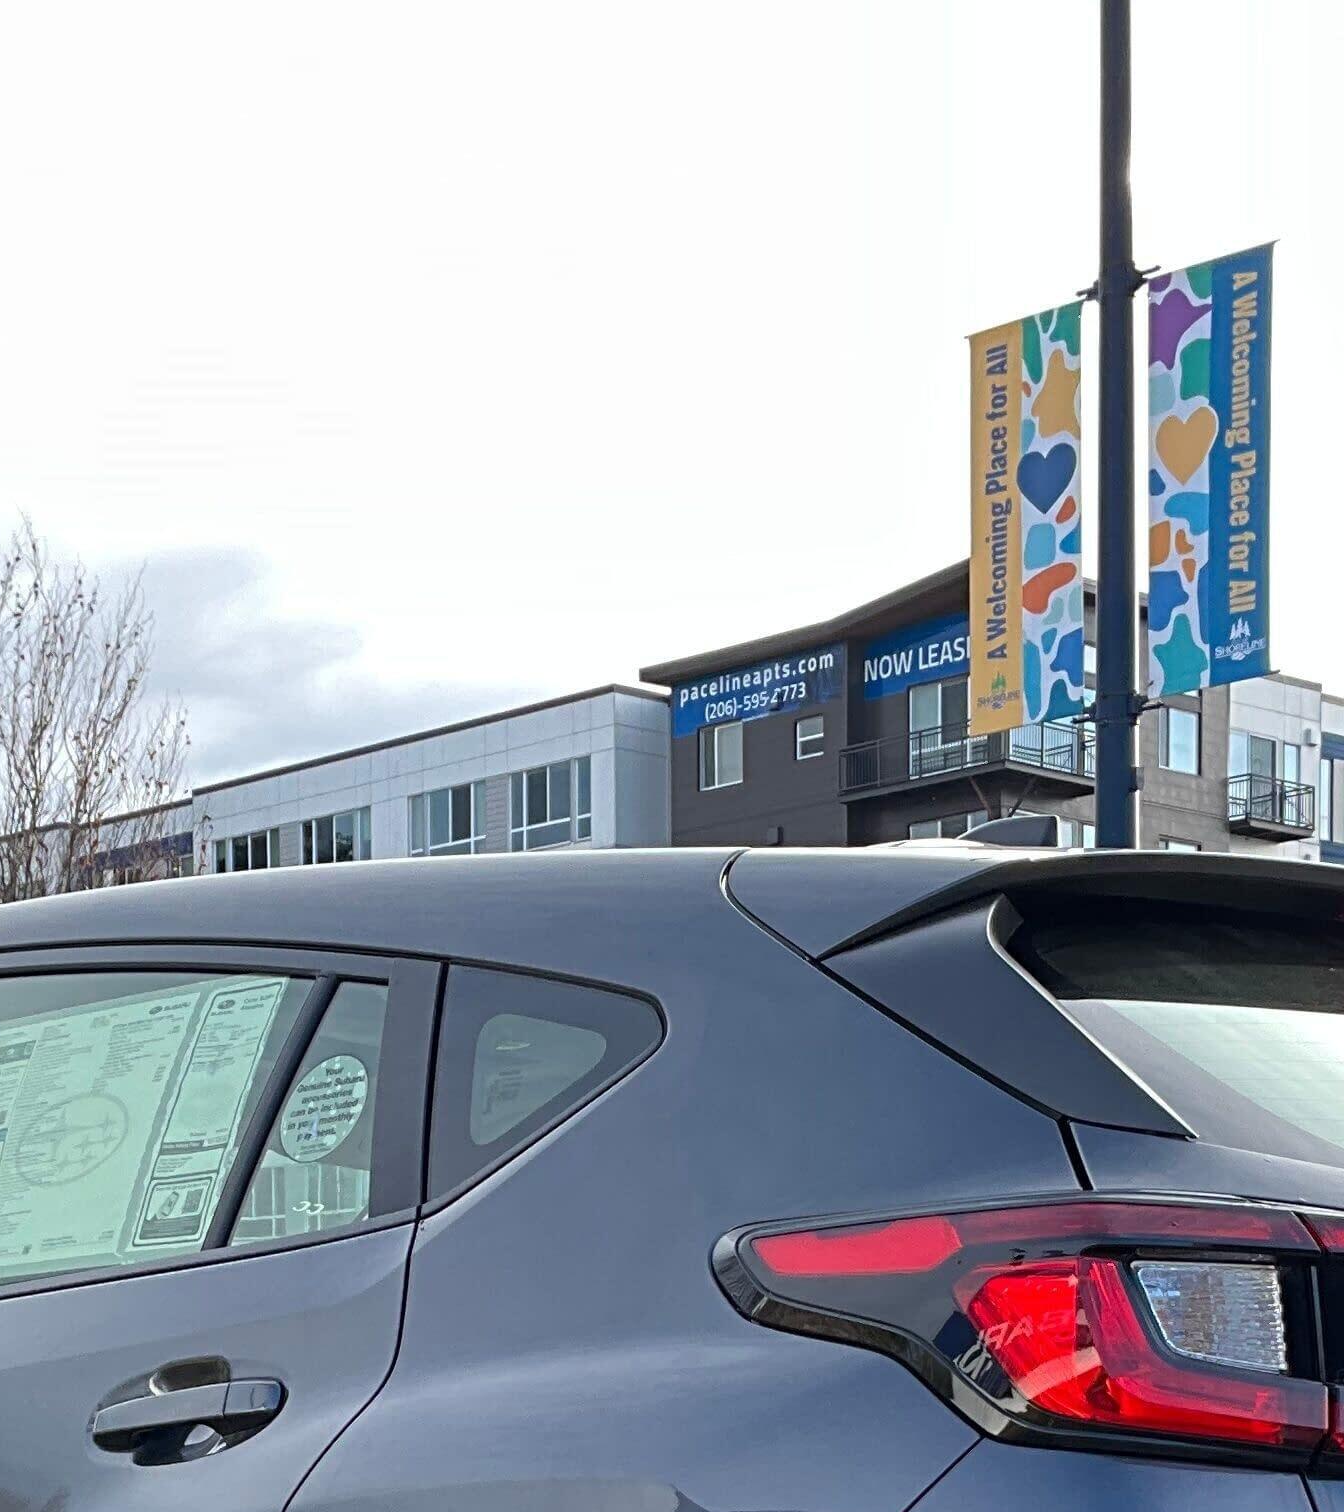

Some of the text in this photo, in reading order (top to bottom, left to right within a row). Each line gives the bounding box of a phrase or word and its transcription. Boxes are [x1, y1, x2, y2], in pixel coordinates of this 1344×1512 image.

[985, 343, 1012, 660] A Welcoming Place for All
[1225, 272, 1258, 615] A Welcoming Place for All
[680, 652, 834, 708] pacelineapts.com
[864, 636, 971, 683] NOW LEASI
